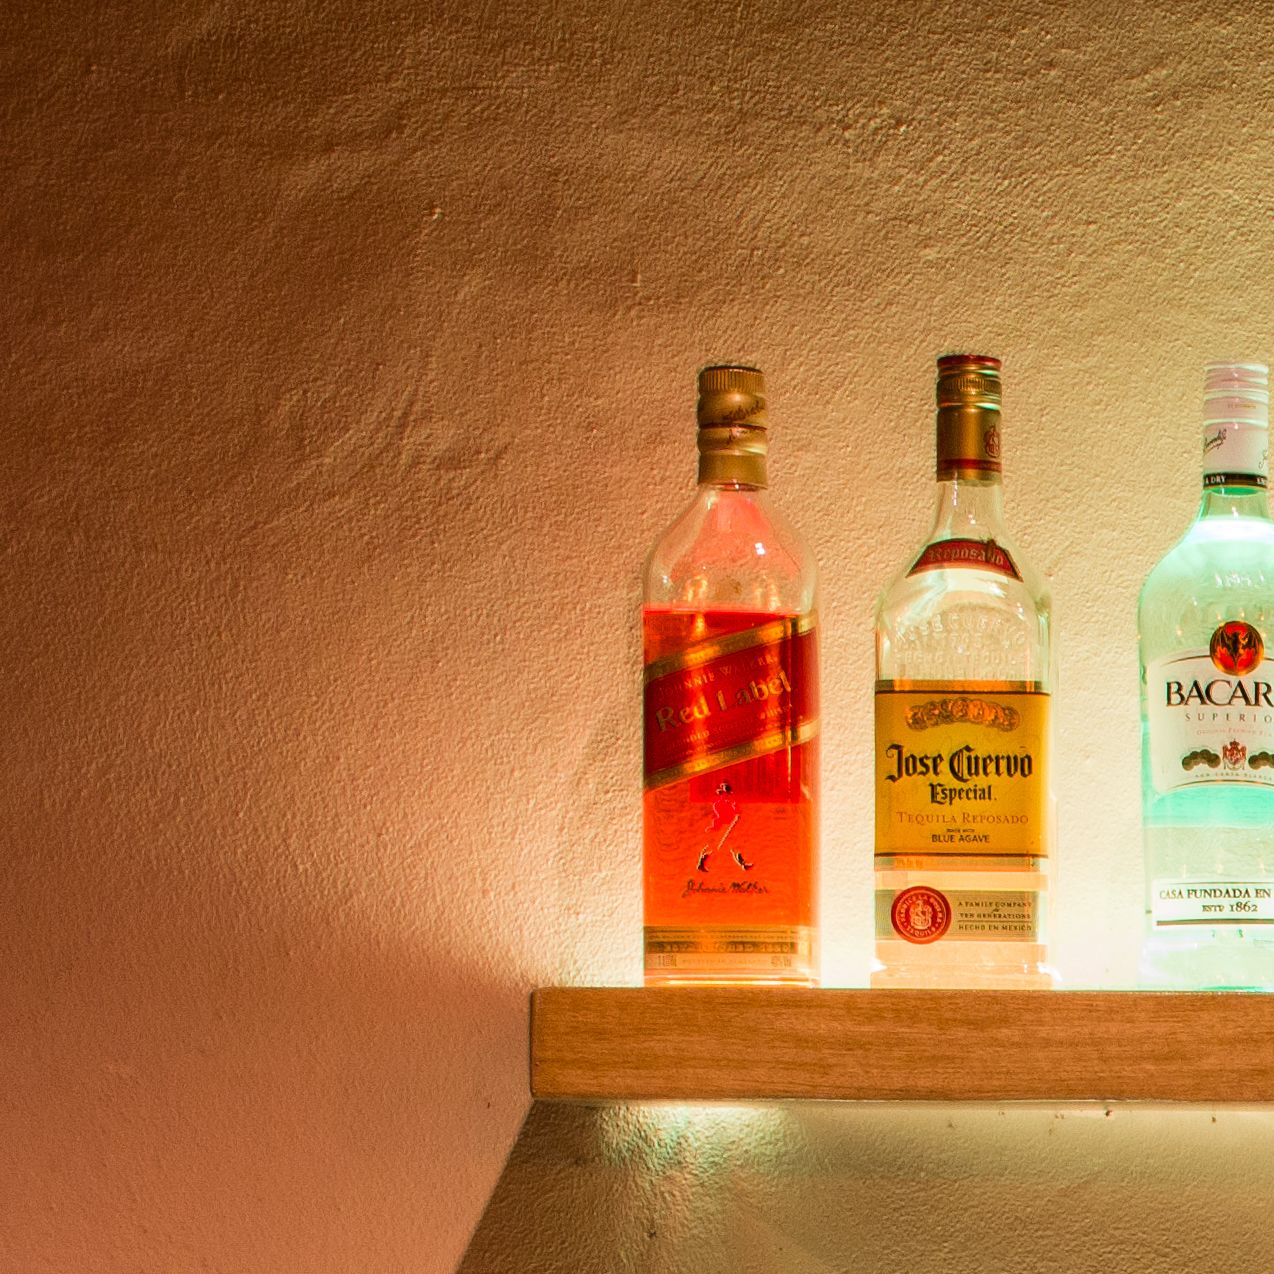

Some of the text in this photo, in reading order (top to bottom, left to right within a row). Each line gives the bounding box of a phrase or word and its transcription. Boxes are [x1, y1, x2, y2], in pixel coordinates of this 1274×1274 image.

[655, 669, 792, 733] Red Label
[885, 742, 1033, 783] Jose Cuervo
[961, 811, 1029, 826] REPOSADO
[931, 834, 990, 844] BLUE AGAVE
[1159, 889, 1183, 900] CASA
[1186, 888, 1251, 900] FUNDADA
[1254, 888, 1272, 900] EN
[1228, 901, 1259, 913] 1862
